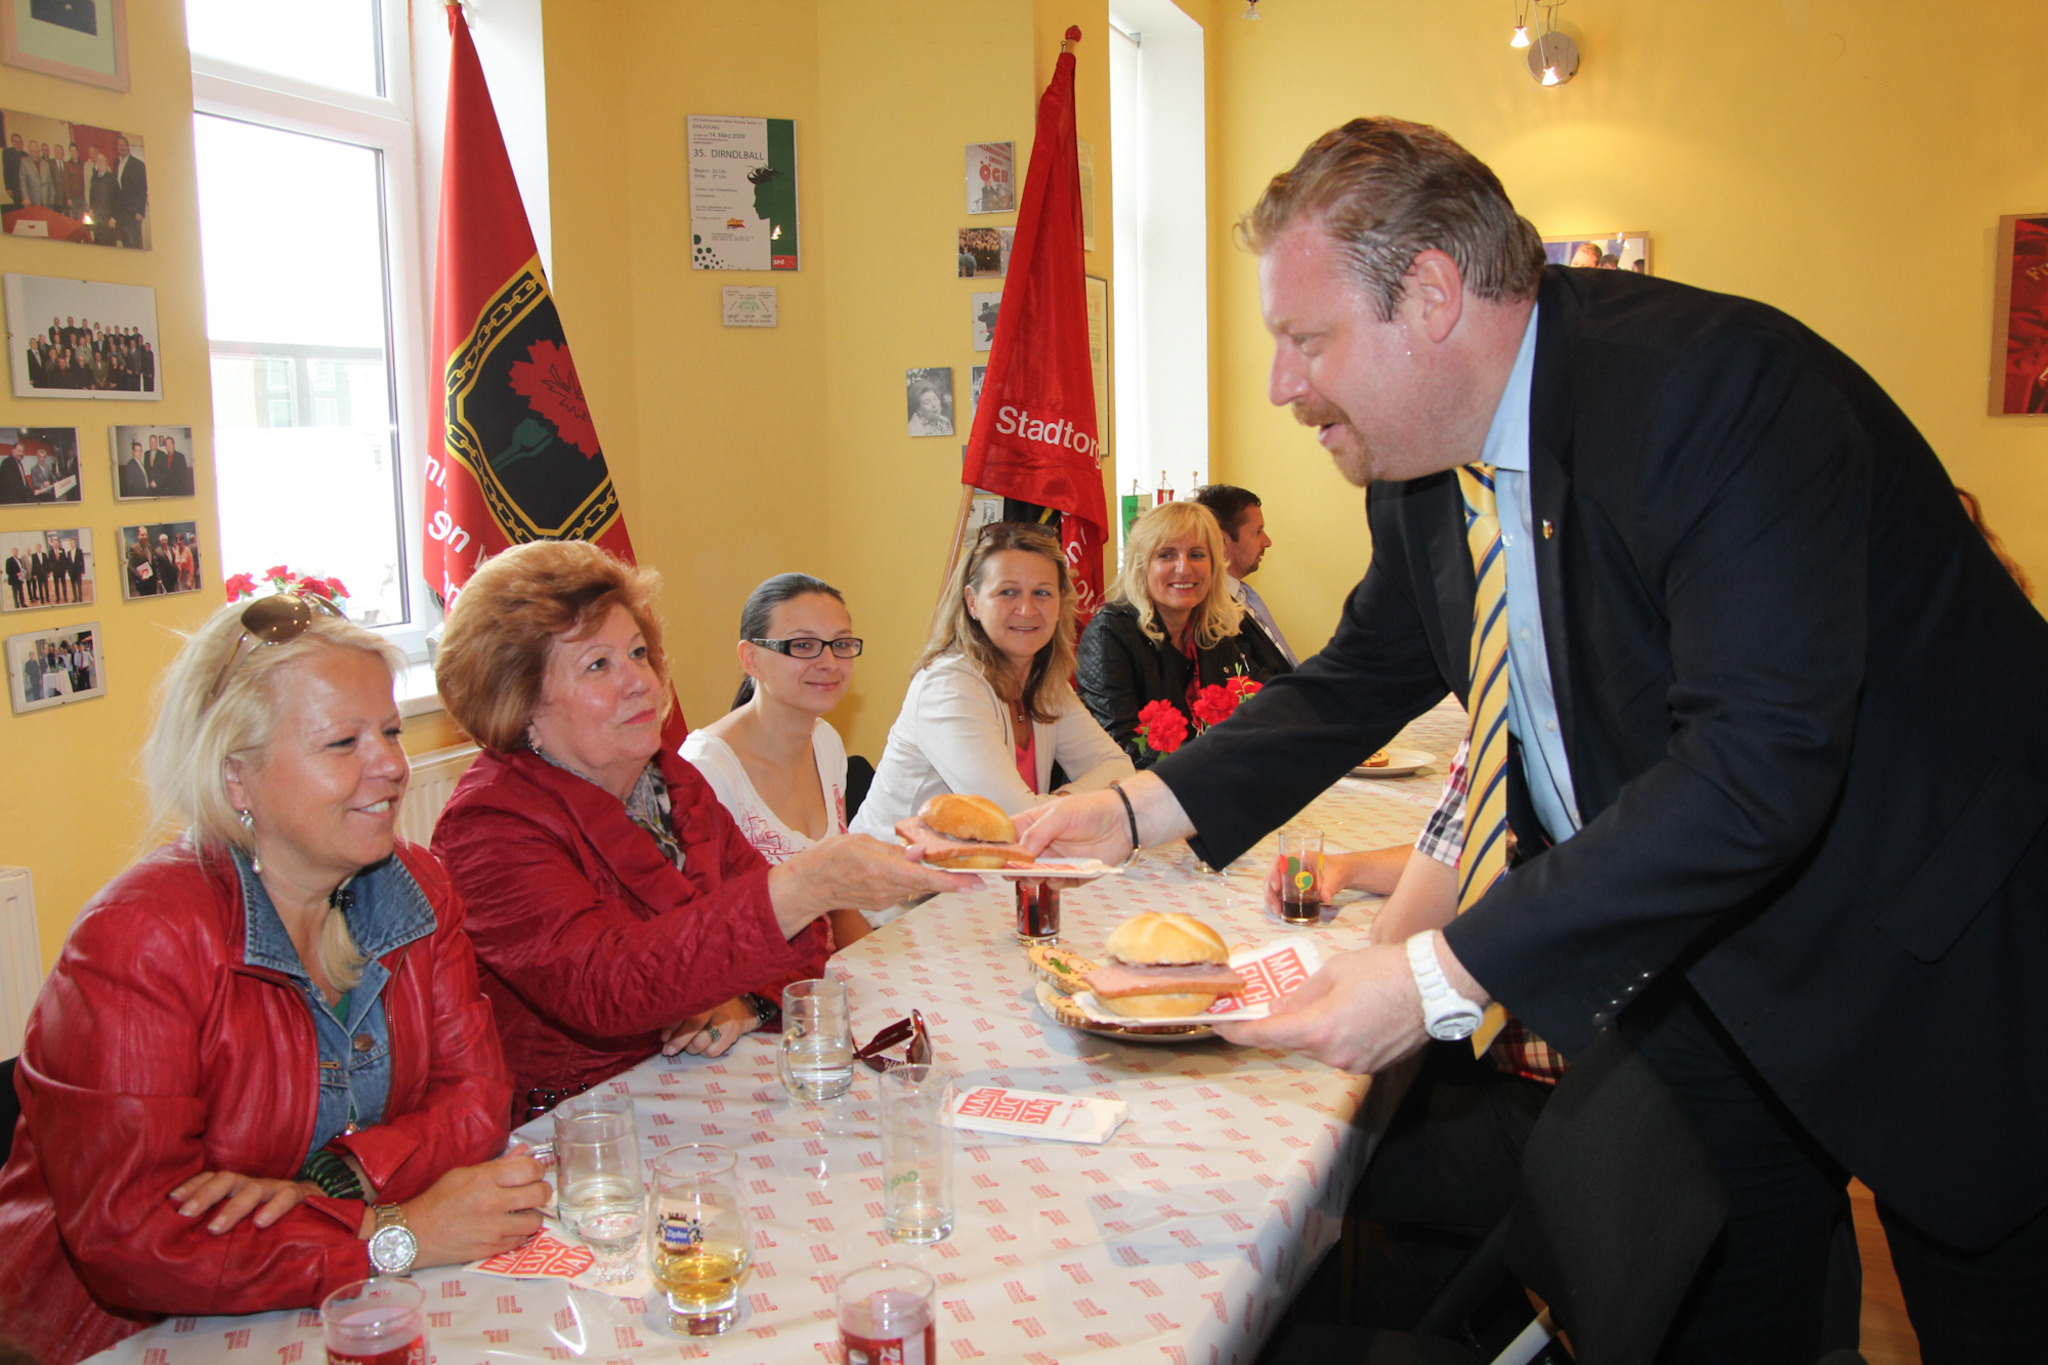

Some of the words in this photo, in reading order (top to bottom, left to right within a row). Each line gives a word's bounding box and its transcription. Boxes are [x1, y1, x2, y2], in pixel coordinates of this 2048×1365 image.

[694, 149, 706, 158] 35.
[711, 149, 764, 160] DIRNDLBALL
[979, 160, 1008, 183] ÖGB
[773, 258, 785, 266] SPÖ
[991, 1097, 1022, 1119] EUC
[666, 1228, 688, 1239] Zipfer
